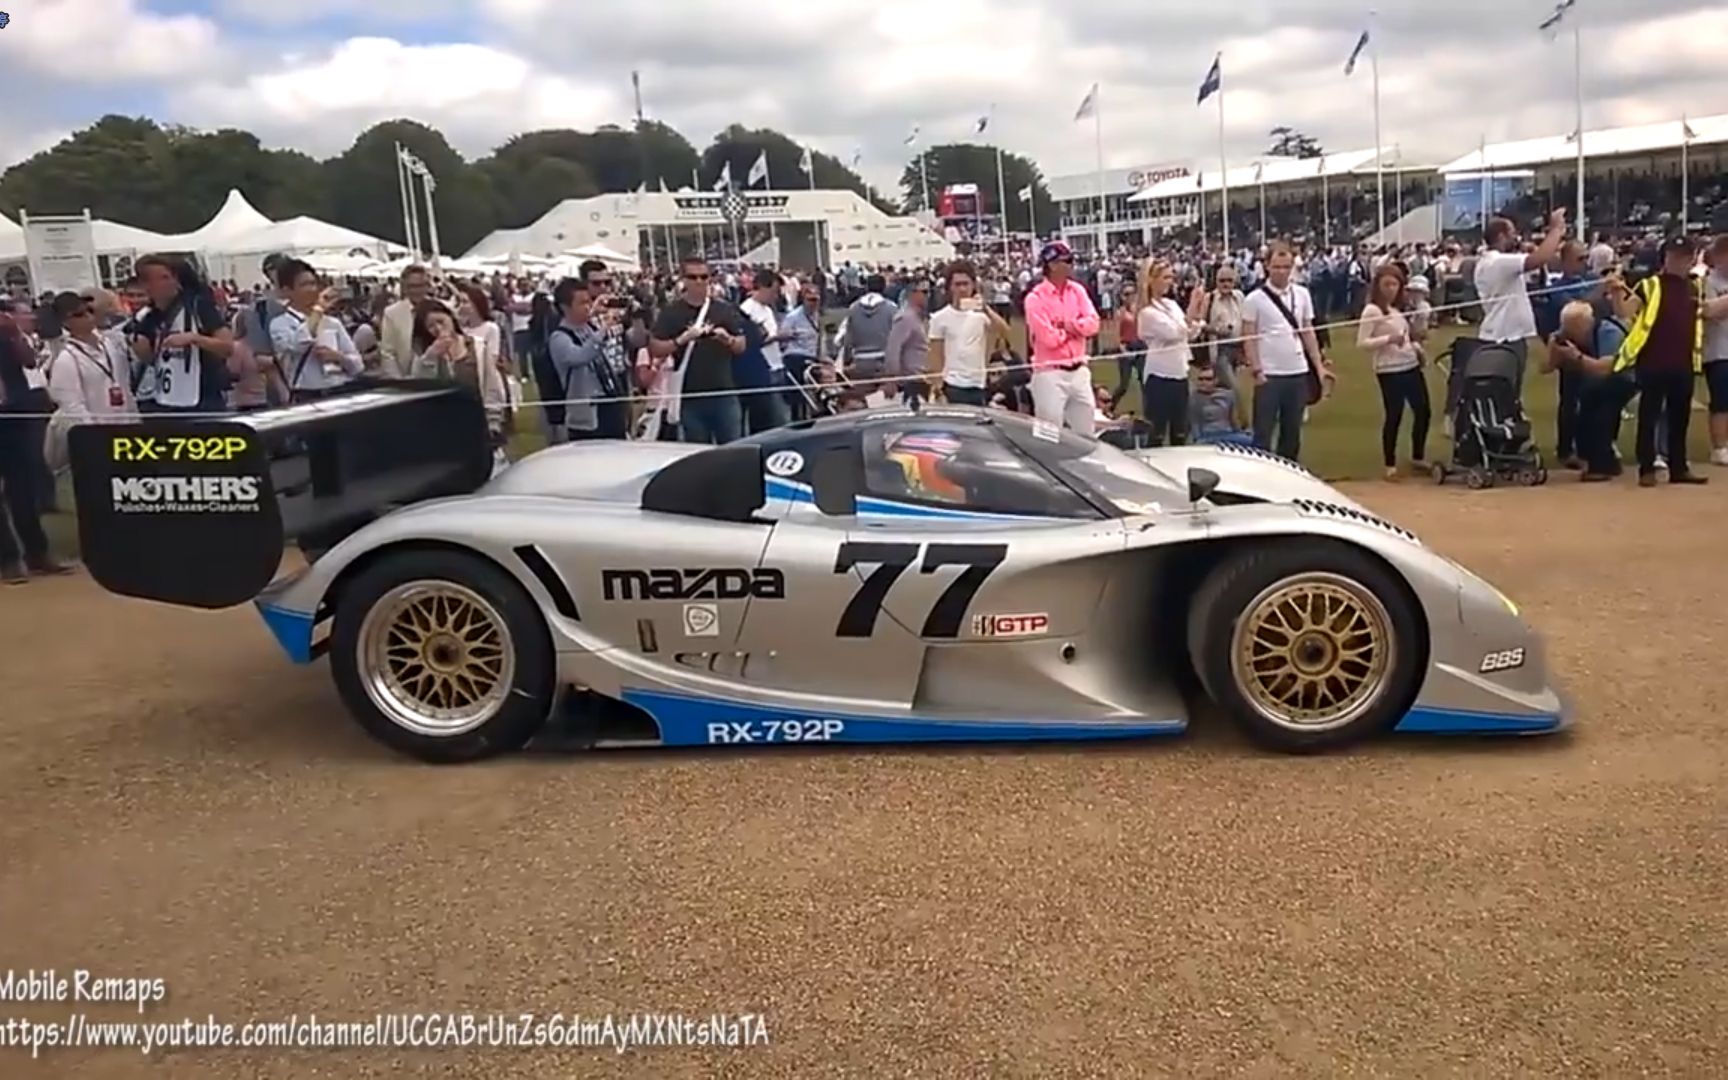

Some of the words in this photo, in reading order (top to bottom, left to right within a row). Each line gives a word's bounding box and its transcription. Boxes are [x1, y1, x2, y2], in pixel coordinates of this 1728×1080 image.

[1147, 167, 1191, 184] TOYOTA
[113, 437, 247, 461] RX-792P
[111, 476, 259, 501] MOTHERS
[602, 568, 785, 600] mazda
[834, 541, 1009, 638] 77
[996, 615, 1048, 633] GTP
[1480, 646, 1524, 672] BBS
[707, 719, 844, 744] RX-792P
